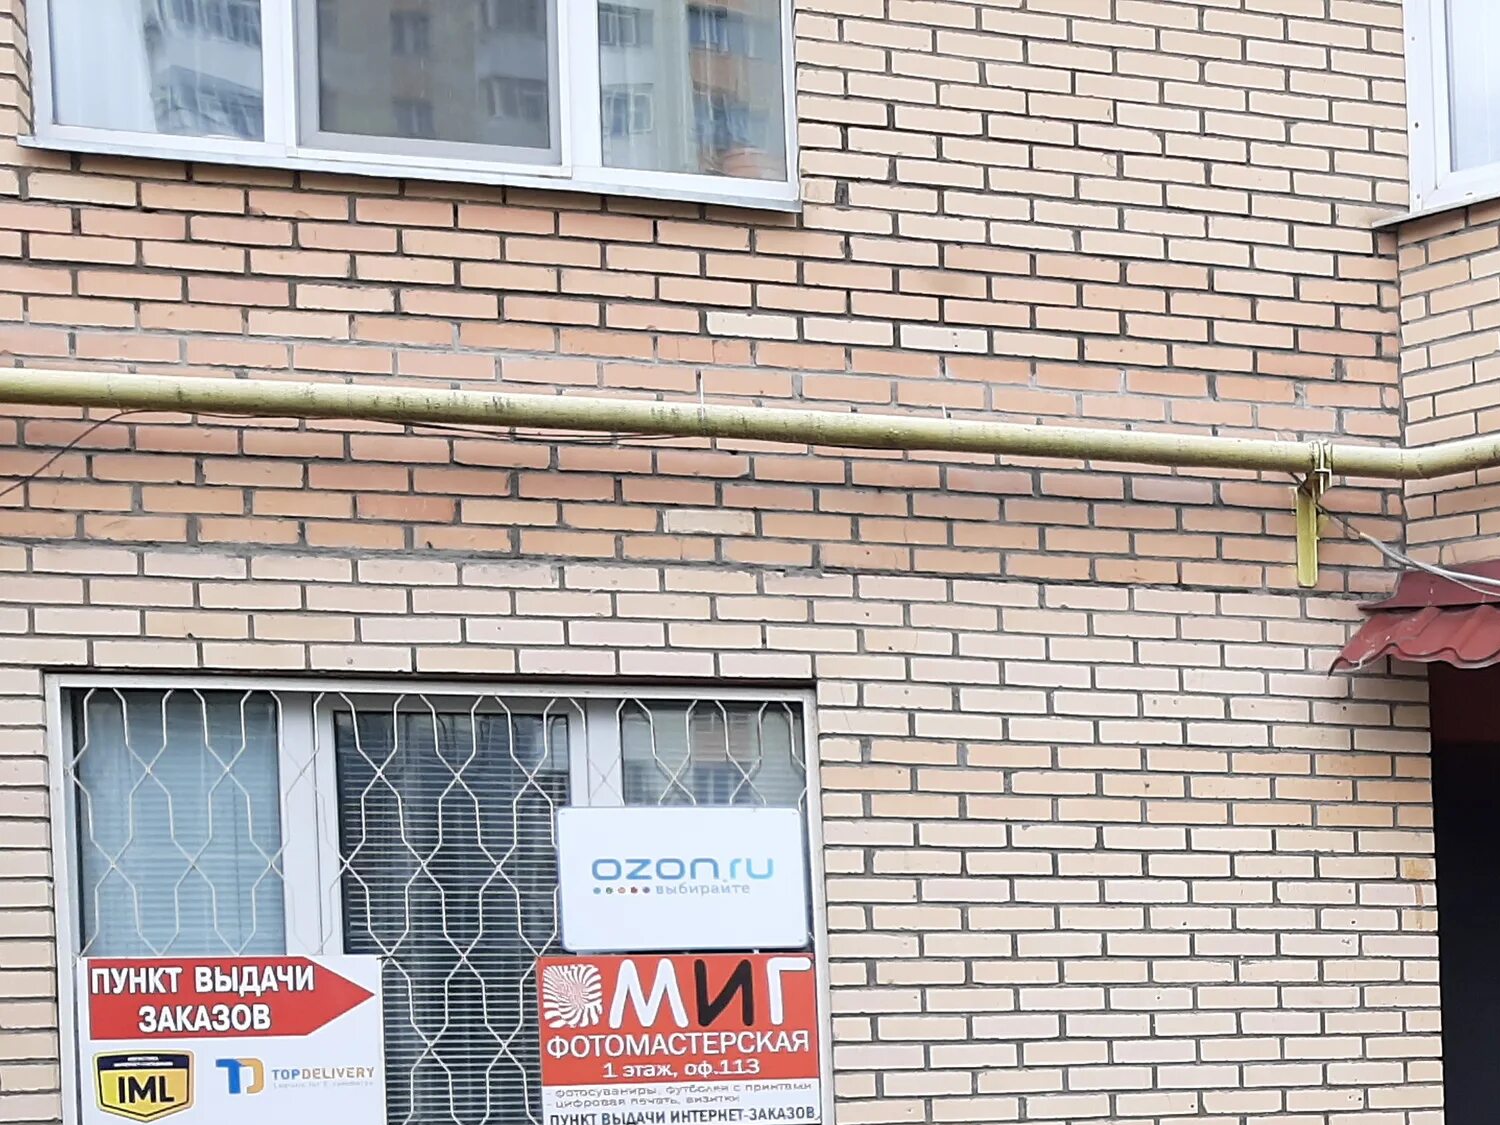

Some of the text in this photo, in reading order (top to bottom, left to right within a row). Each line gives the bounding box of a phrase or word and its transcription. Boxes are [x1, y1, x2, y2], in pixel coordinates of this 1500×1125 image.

[591, 857, 774, 882] ozon.ru
[90, 964, 316, 996] ПУНКТ ВЫДАЧИ
[608, 958, 813, 1030] МИГ
[138, 1003, 273, 1033] ЗАКАЗОВ
[546, 1030, 810, 1060] ФОТОМАСТЕРСКАЯ
[603, 1058, 760, 1078] 1 этаж, оф.113
[117, 1075, 176, 1104] IML
[670, 1104, 816, 1125] ИНТЕРНЕТ-ЗАКАЗОВ
